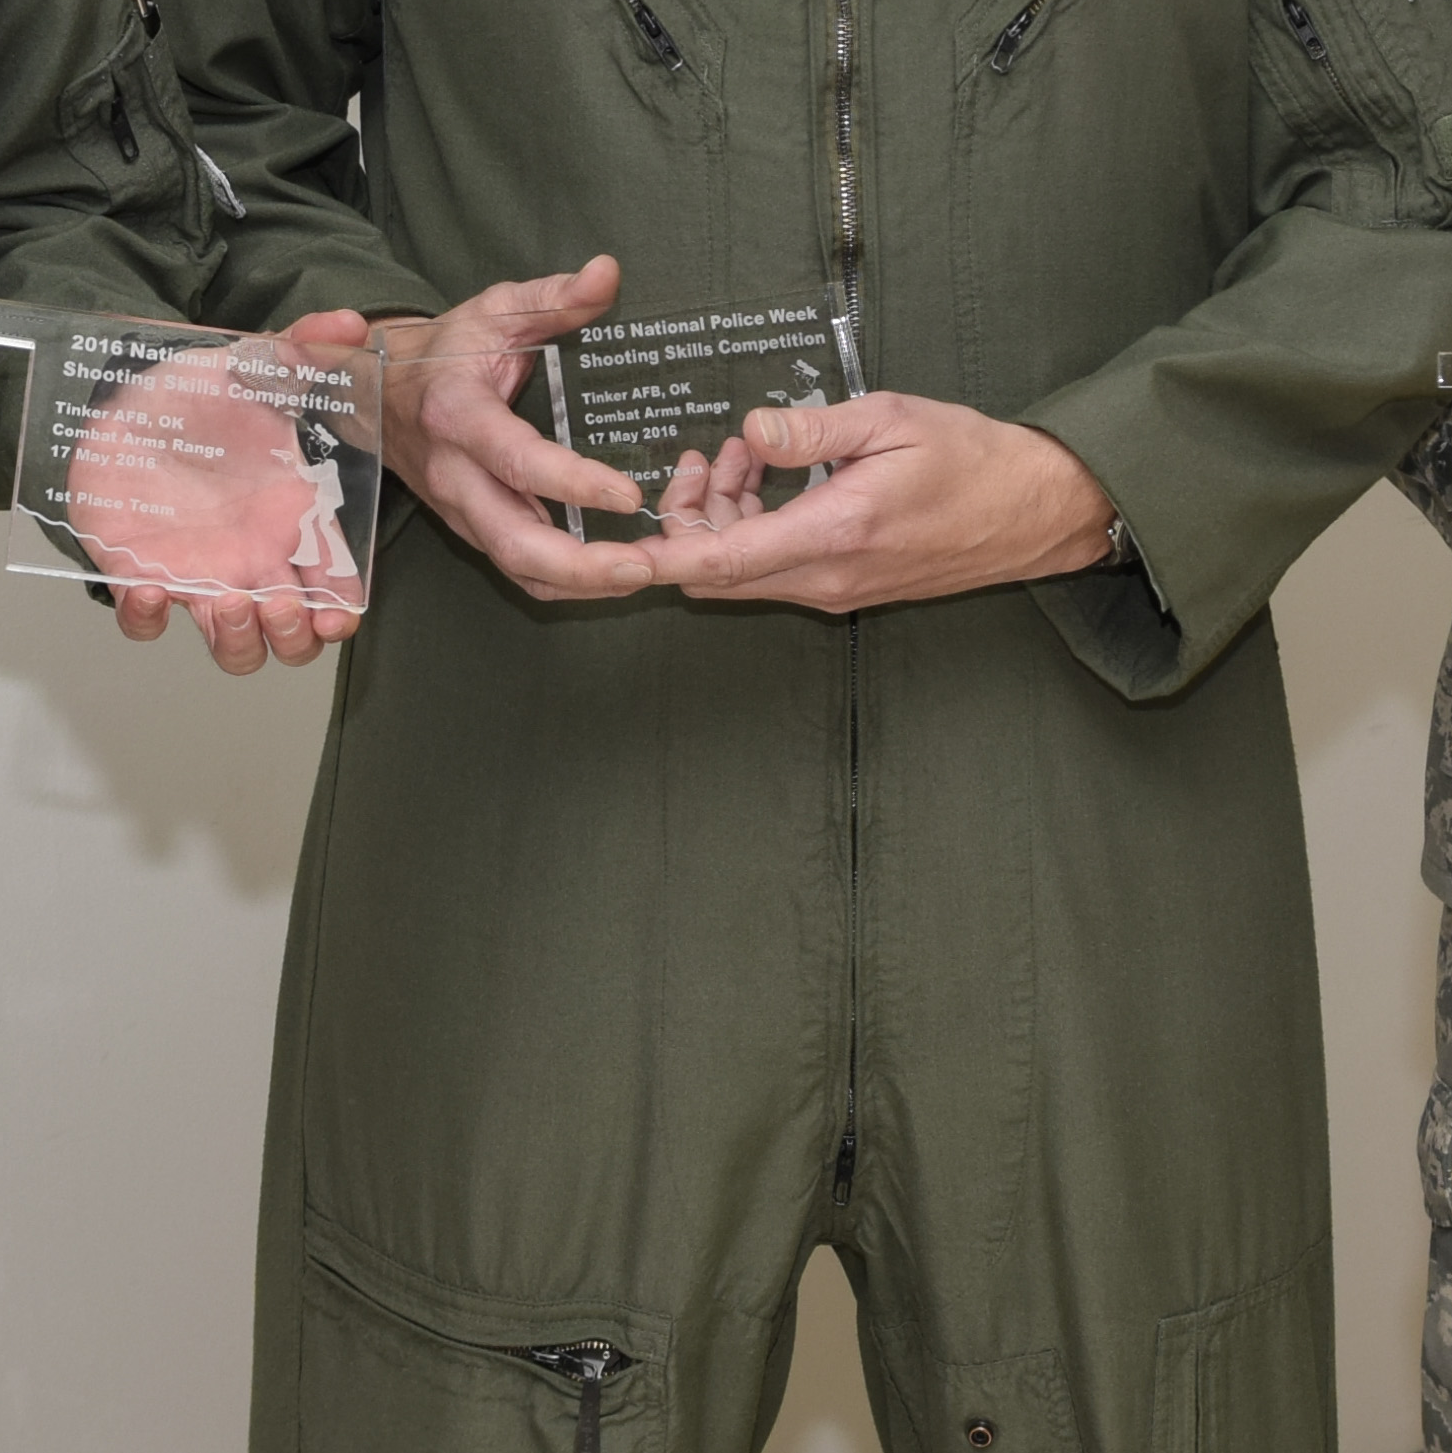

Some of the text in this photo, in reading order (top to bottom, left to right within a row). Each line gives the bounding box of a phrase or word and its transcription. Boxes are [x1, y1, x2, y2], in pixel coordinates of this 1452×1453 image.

[581, 306, 817, 343] 2016 National Police Week
[71, 335, 353, 387] 2016 National Police Week
[579, 332, 826, 369] Shooting Skills Competition
[63, 362, 355, 414] Shooting Skills Competition
[582, 382, 691, 405] Tinker AFB, OK
[55, 401, 185, 429] Tinker AFB, OK
[585, 399, 730, 425] Combat Arms Range
[52, 424, 225, 458] Combat Arms Range
[588, 424, 677, 446] 17 May 2016
[50, 445, 156, 469] 17 May 2016
[664, 463, 703, 477] Team
[45, 487, 175, 516] 1st Place Team
